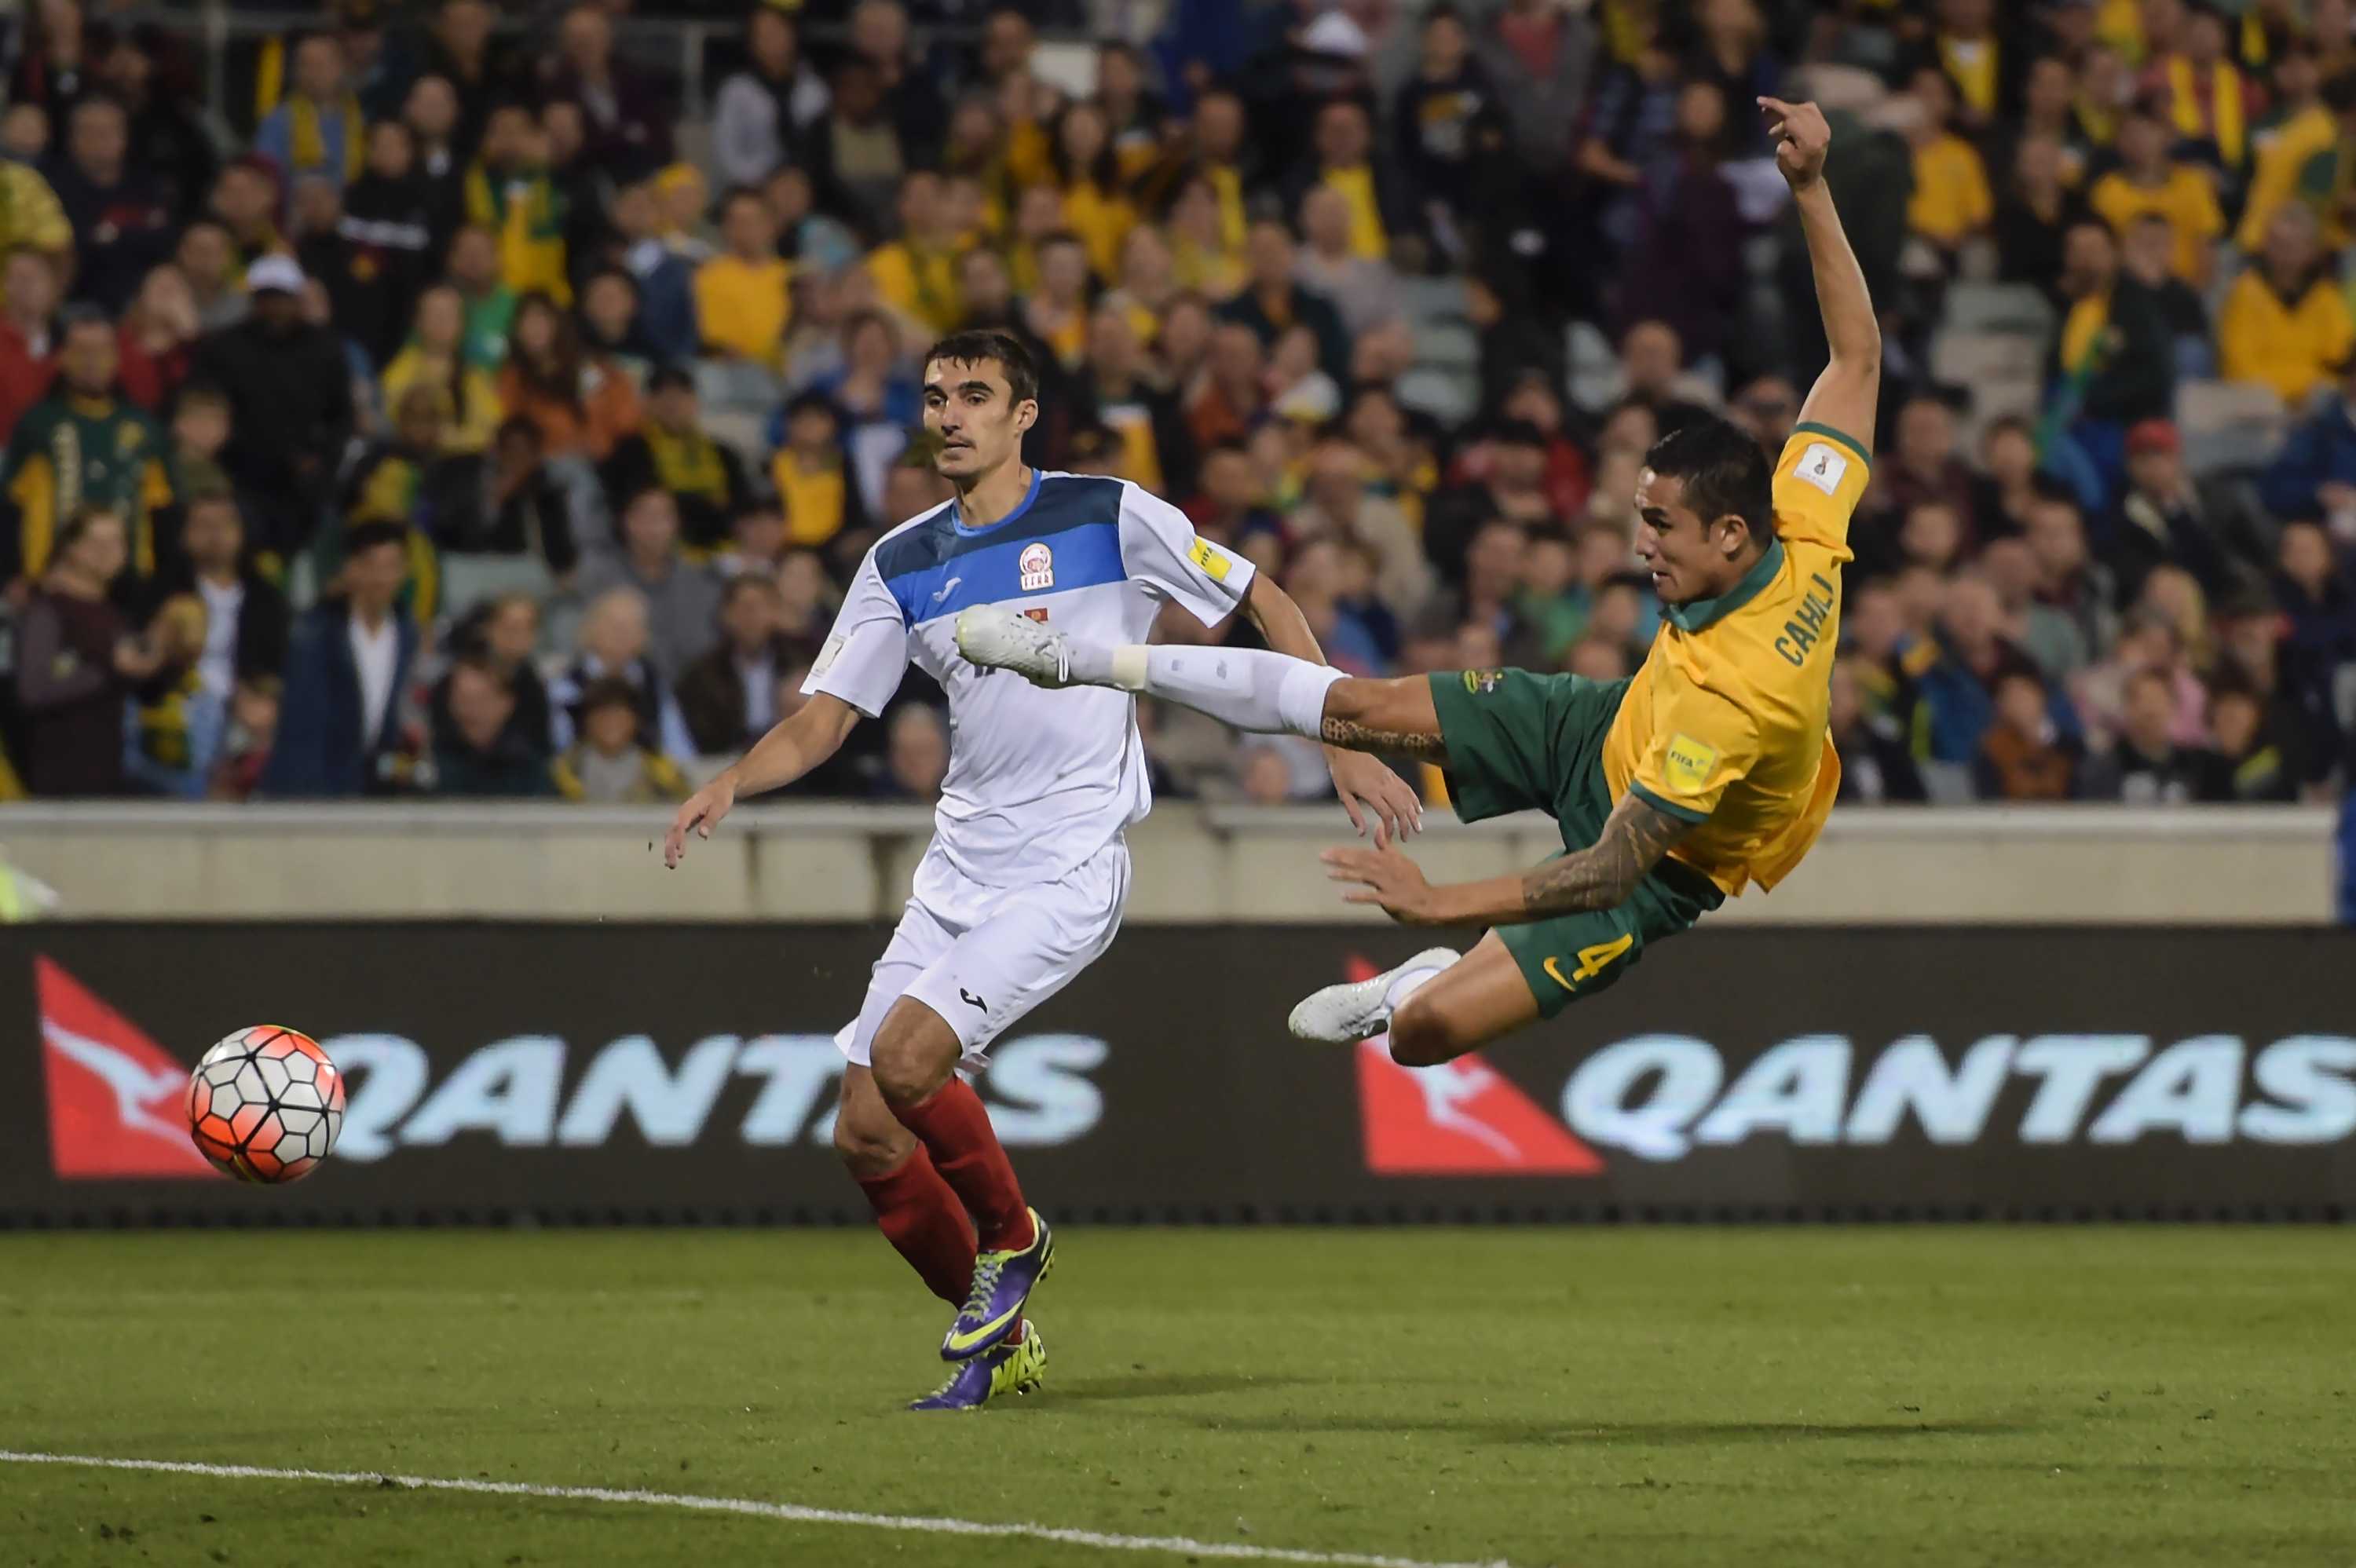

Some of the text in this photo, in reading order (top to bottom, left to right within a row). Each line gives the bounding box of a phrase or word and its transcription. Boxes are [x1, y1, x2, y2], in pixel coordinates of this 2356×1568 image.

[1670, 751, 1693, 768] FIFA
[1573, 933, 1633, 981] 4
[317, 1033, 1110, 1164] QANTS
[1563, 1033, 2356, 1160] QANTAS
